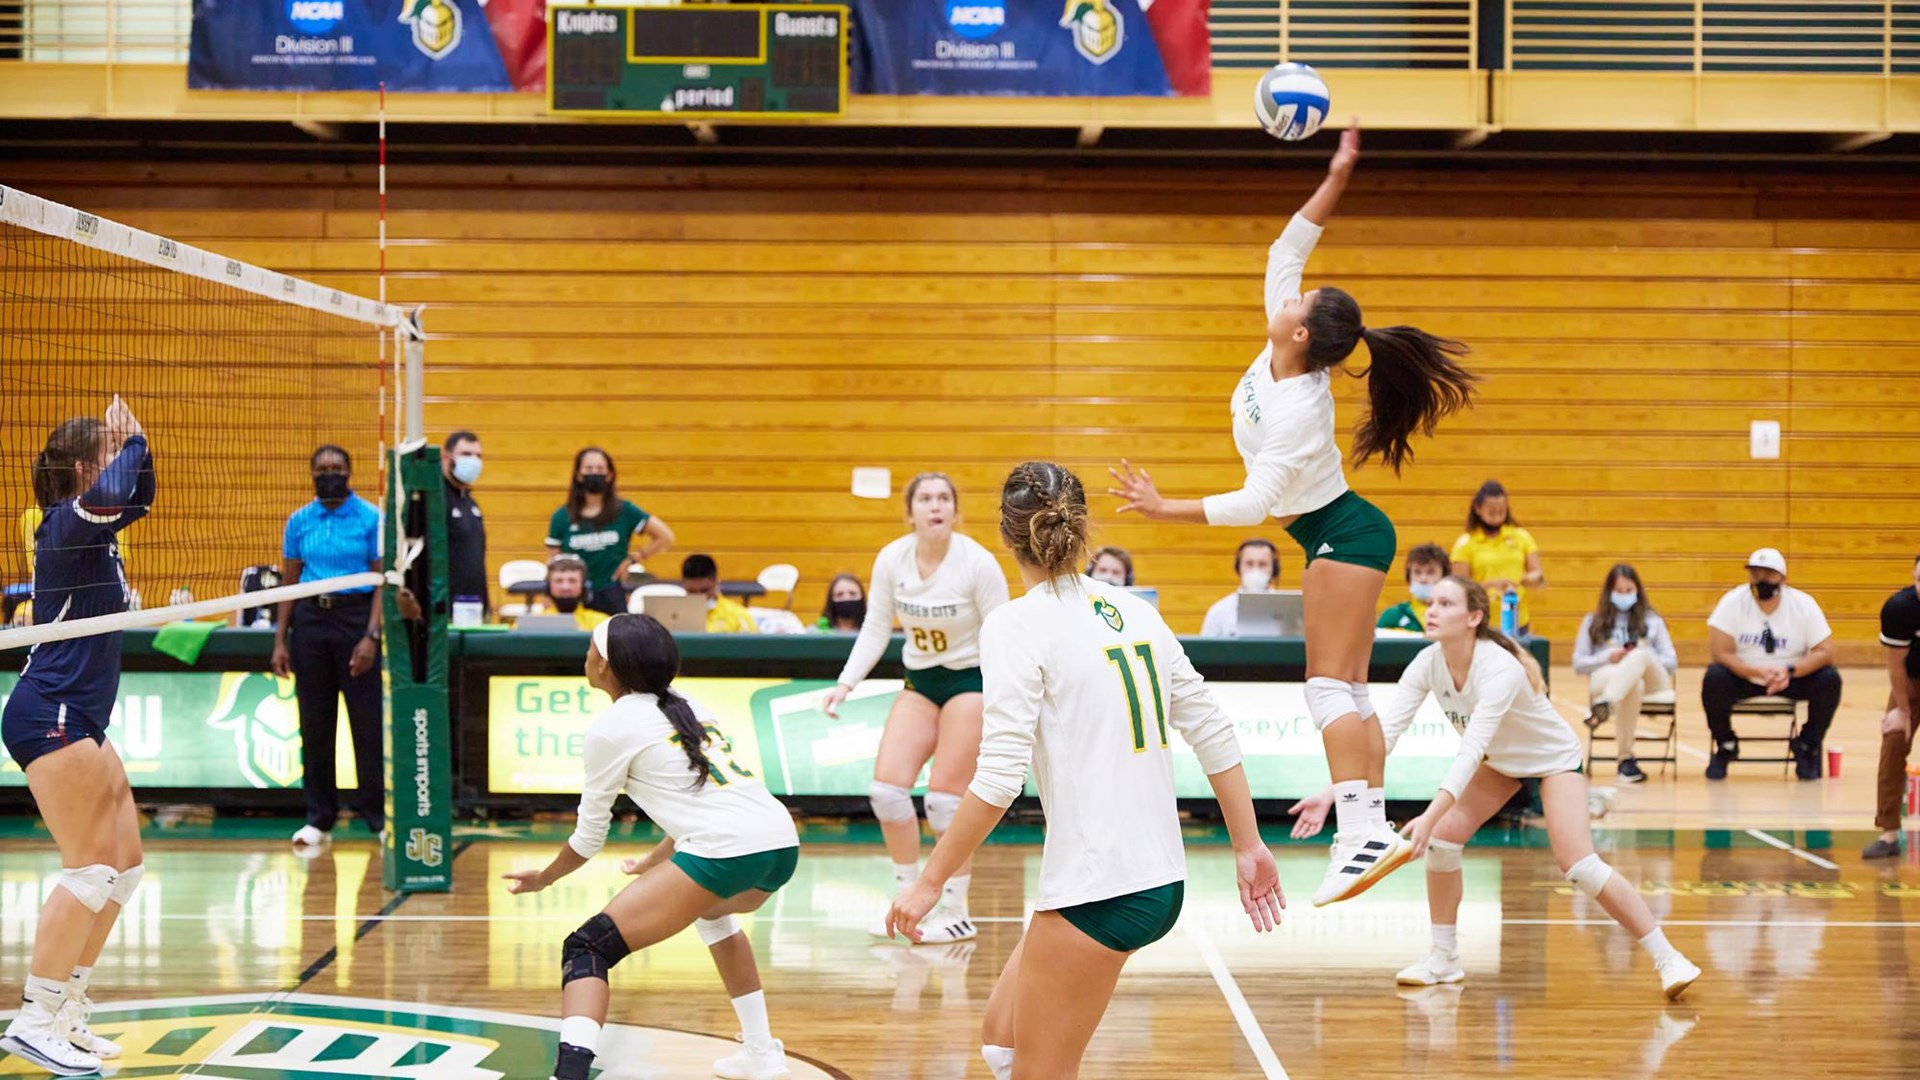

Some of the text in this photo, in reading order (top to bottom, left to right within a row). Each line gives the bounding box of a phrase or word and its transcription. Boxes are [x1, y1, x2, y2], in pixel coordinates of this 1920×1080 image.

[556, 11, 618, 34] Knights
[774, 12, 838, 37] Guests
[275, 35, 354, 54] Division III
[935, 40, 1000, 59] Division
[674, 86, 734, 109] period
[911, 626, 948, 654] 28
[516, 682, 592, 713] Get
[1103, 640, 1168, 754] 11
[516, 726, 585, 757] the
[413, 707, 432, 817] sports imports
[405, 827, 443, 868] JC
